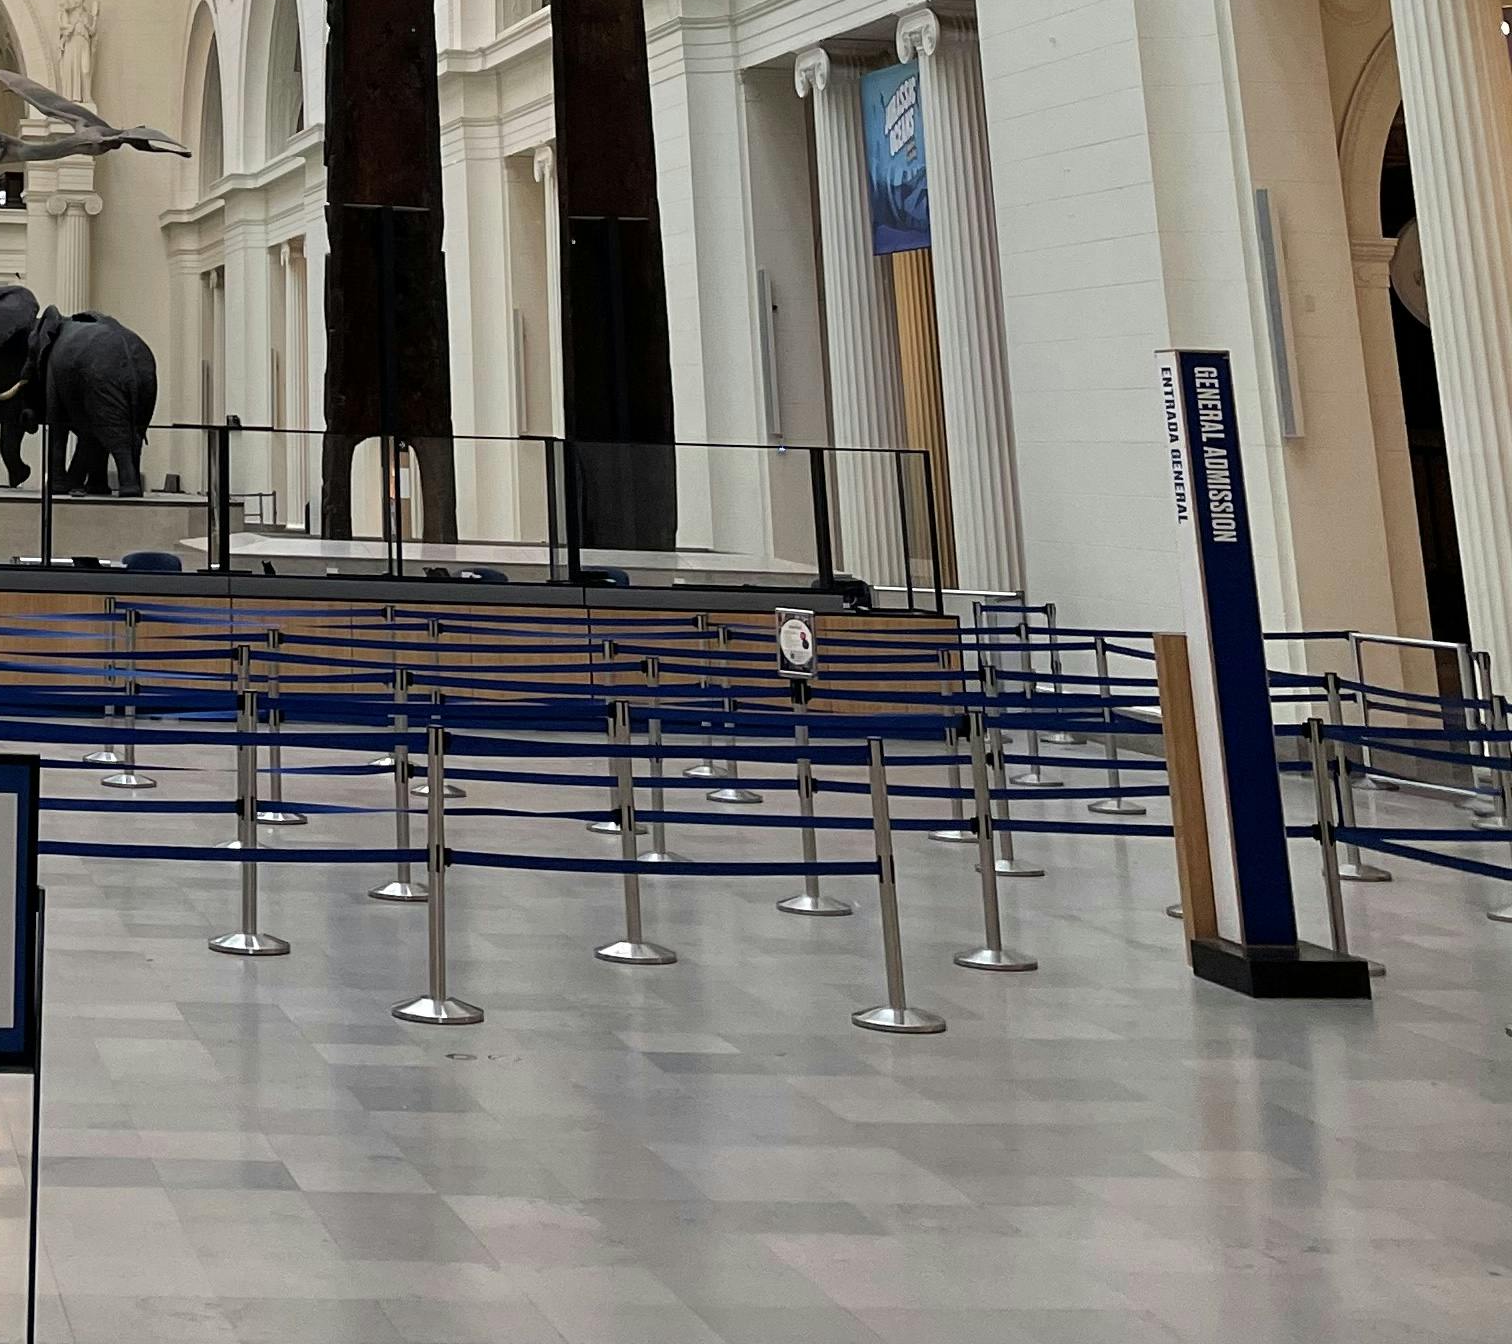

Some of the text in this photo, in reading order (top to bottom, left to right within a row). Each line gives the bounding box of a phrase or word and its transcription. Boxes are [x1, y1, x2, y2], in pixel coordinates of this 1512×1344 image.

[1161, 367, 1189, 524] ENTRADA GENERAL
[1194, 366, 1238, 543] GENERAL ADMISSION
